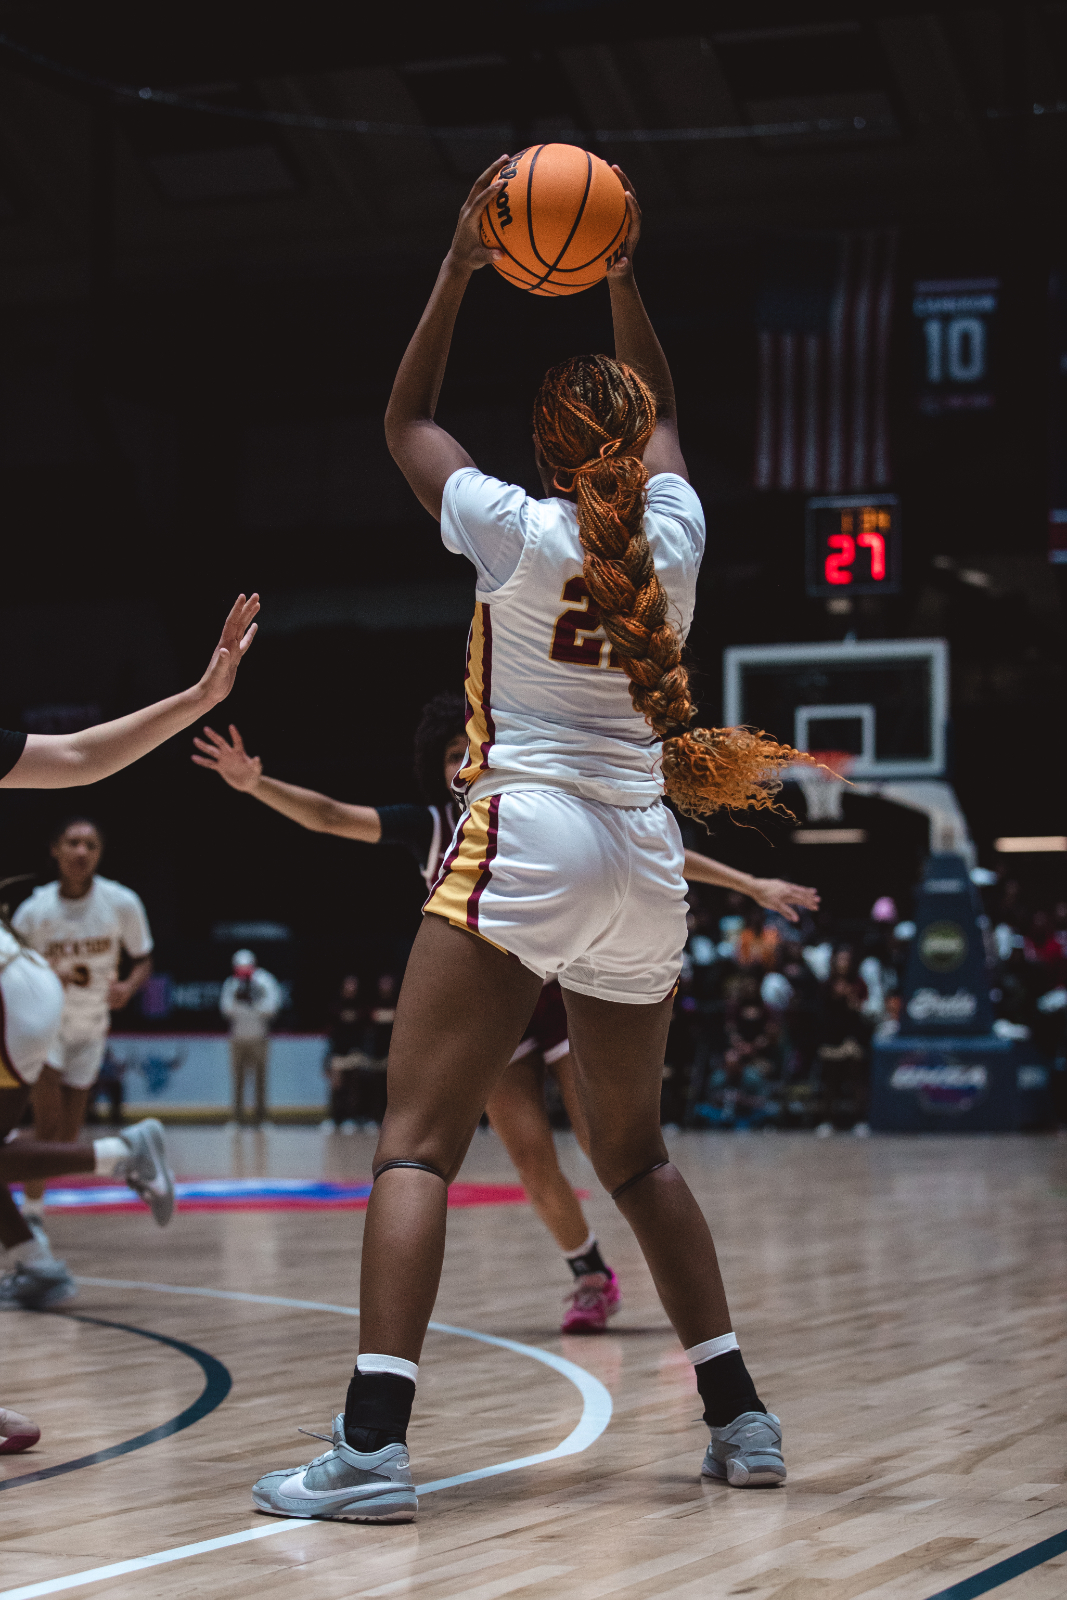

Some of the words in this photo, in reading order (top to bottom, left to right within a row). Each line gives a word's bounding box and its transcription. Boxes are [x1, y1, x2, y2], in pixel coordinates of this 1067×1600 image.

[923, 318, 985, 384] 10
[825, 532, 886, 585] 27
[549, 575, 624, 669] 2
